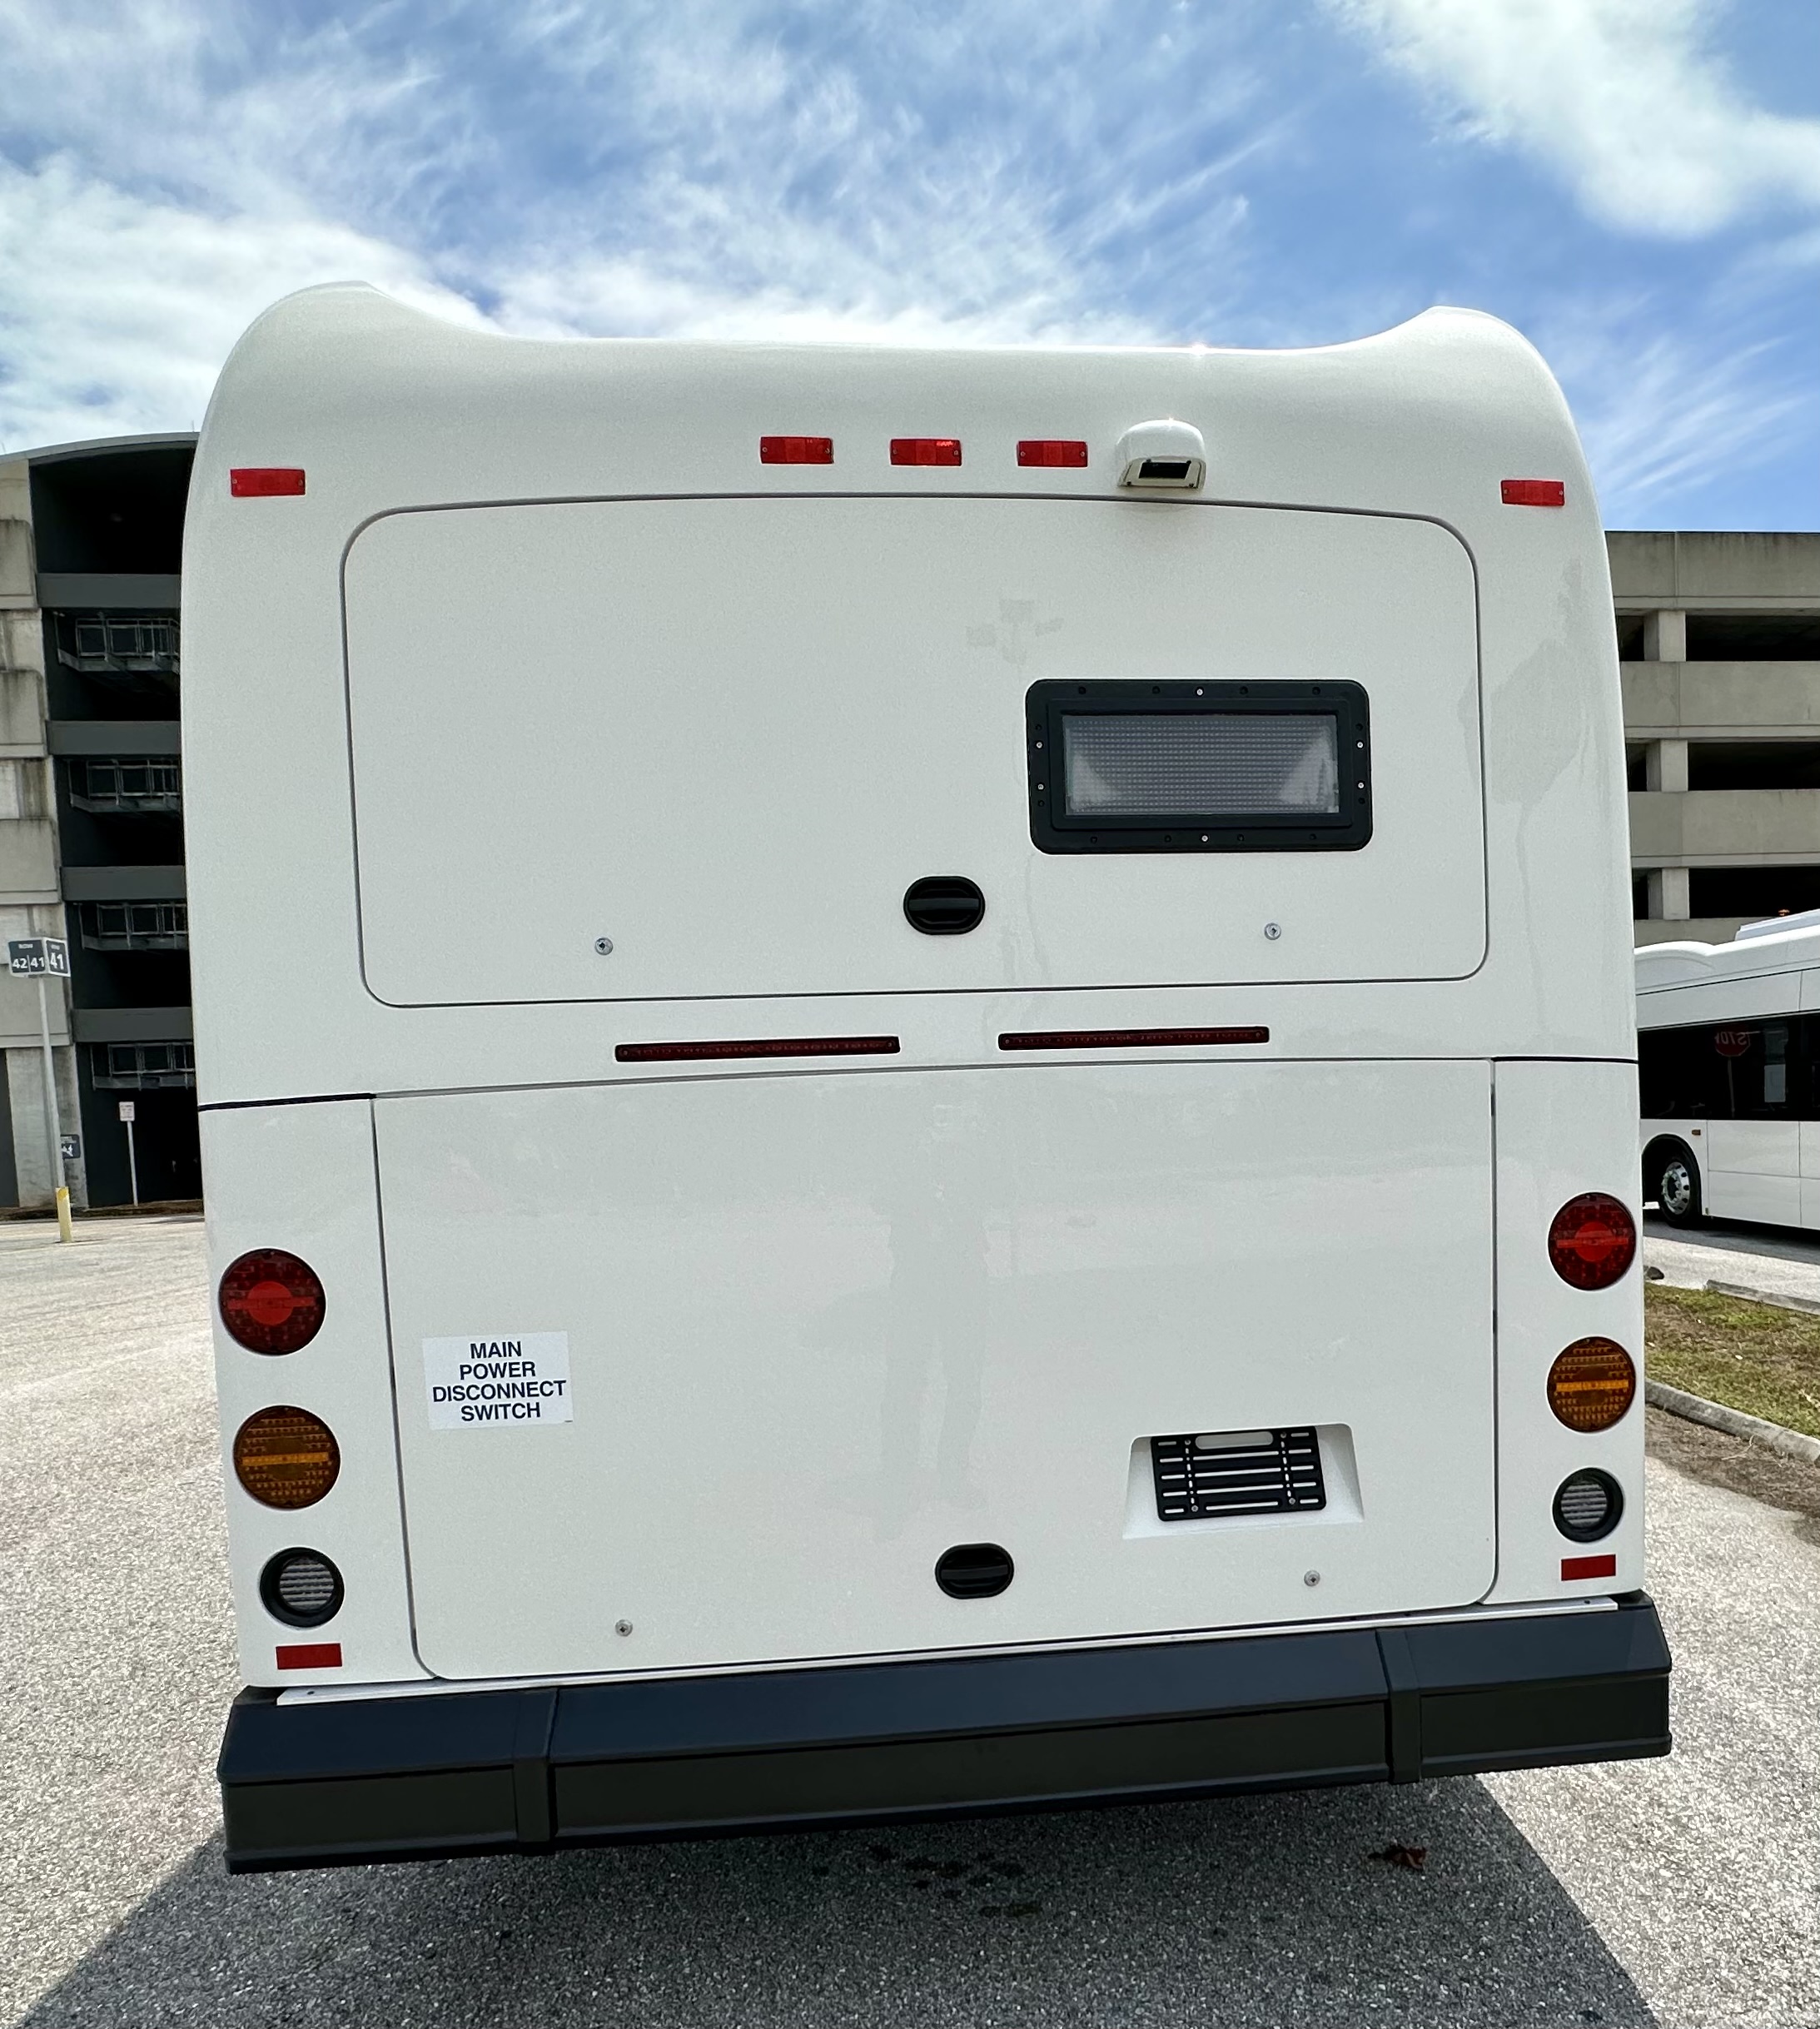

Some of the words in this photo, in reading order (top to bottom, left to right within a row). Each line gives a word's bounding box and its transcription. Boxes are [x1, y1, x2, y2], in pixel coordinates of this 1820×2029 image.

[12, 957, 28, 969] 42
[30, 957, 45, 968] 41
[50, 952, 65, 970] 41
[470, 1340, 522, 1360] MAIN
[460, 1361, 536, 1380] POWER
[432, 1380, 567, 1402] DISCONNECT
[460, 1402, 541, 1422] SWITCH
